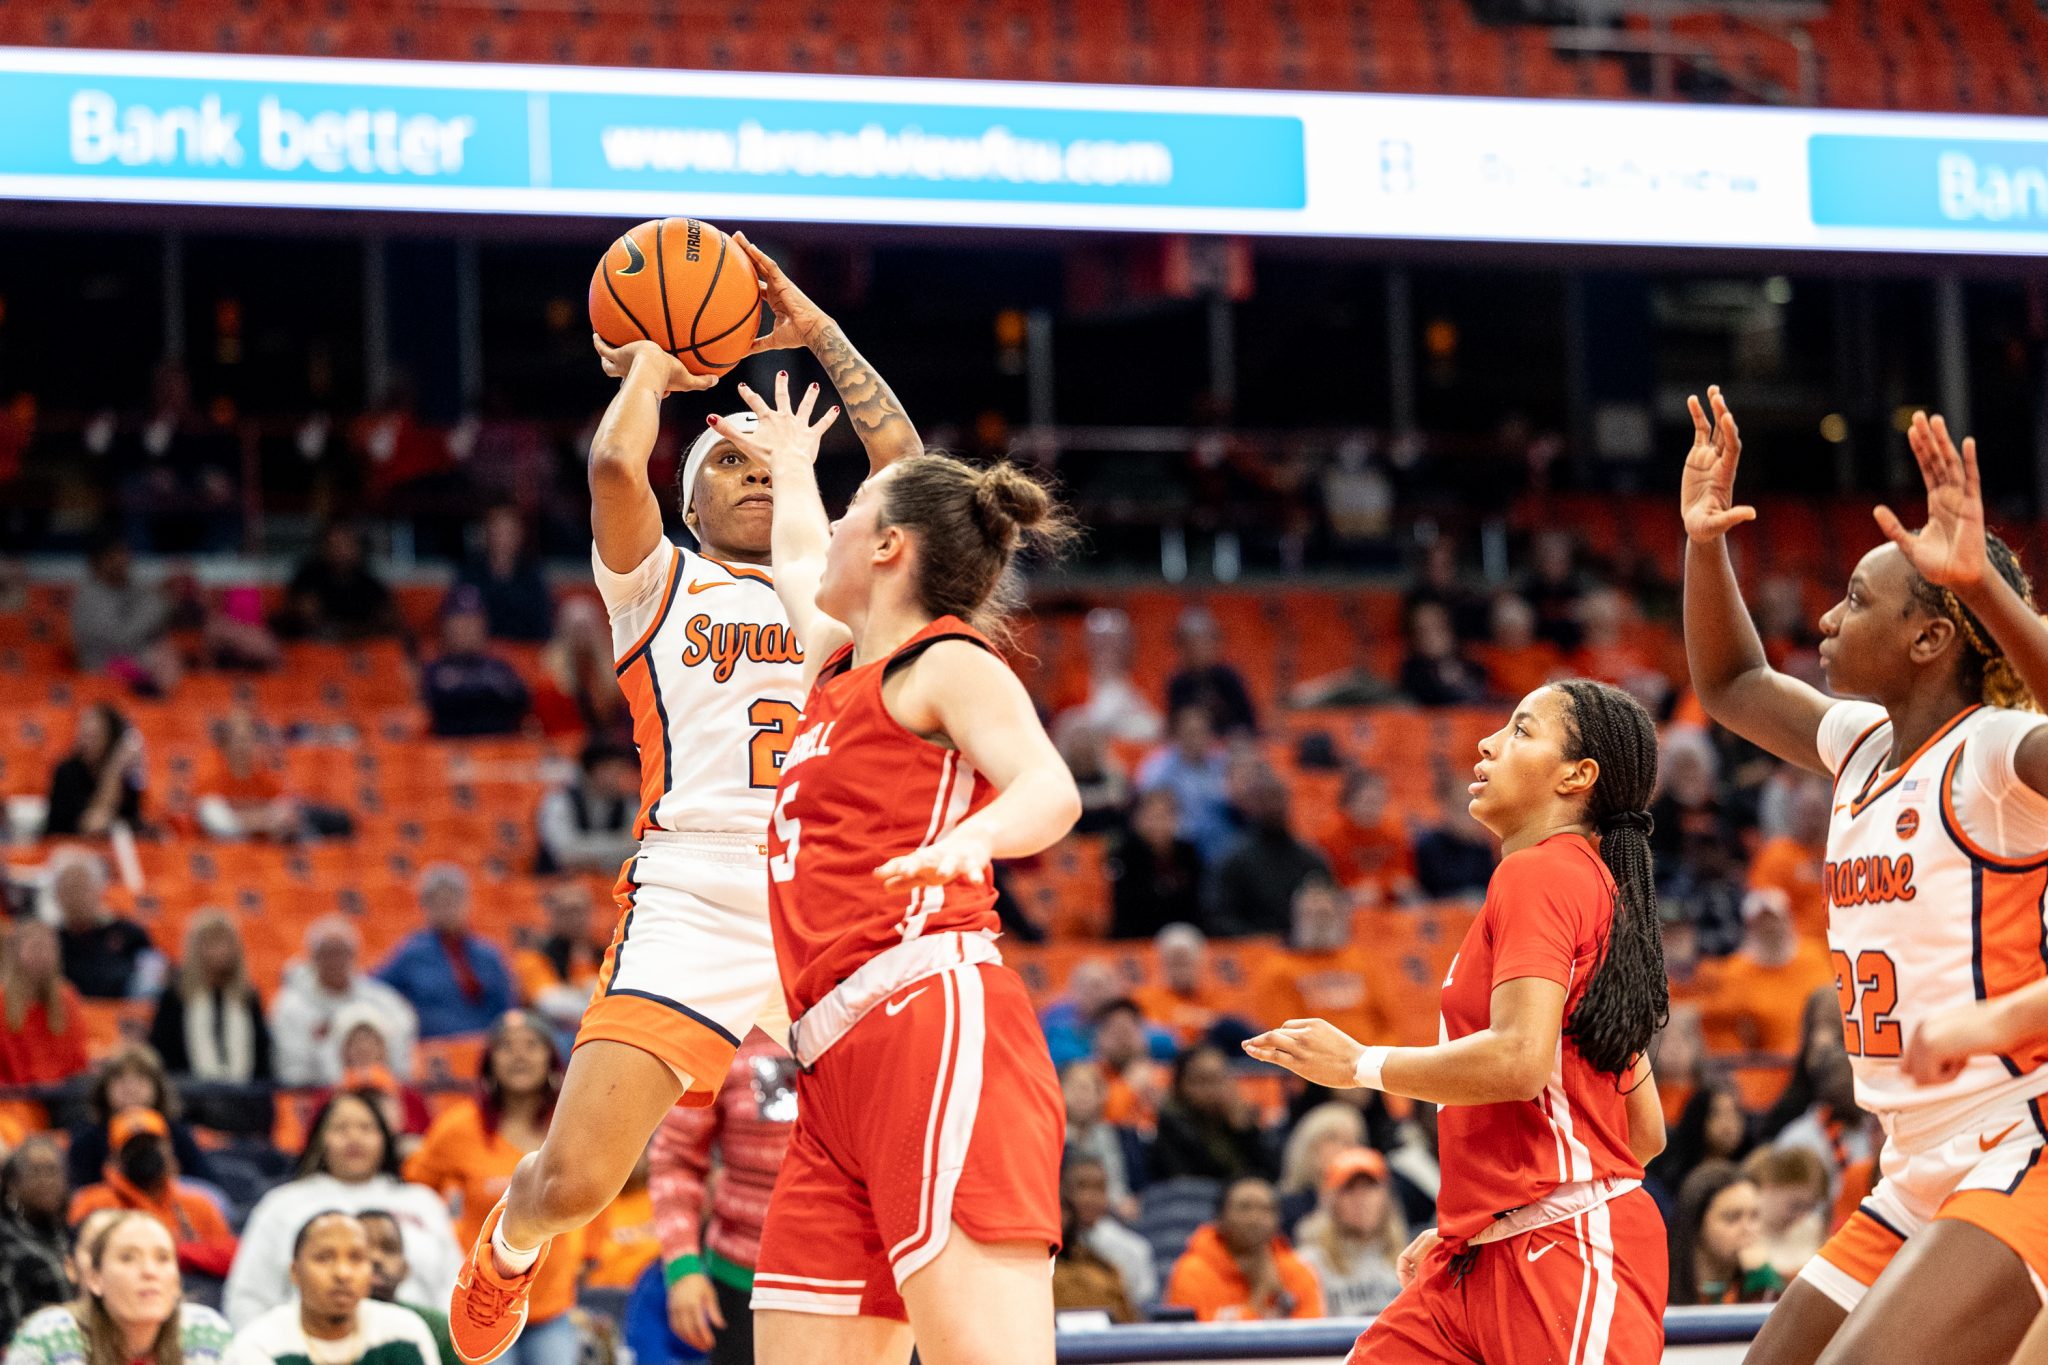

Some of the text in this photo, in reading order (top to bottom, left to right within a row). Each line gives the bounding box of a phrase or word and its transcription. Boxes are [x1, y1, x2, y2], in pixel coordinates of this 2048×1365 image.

[70, 88, 476, 175] Bank better
[681, 613, 804, 683] Syrac
[747, 698, 804, 789] 2
[769, 781, 801, 883] 5
[1824, 853, 1916, 925] racuse
[1830, 949, 1903, 1057] 22
